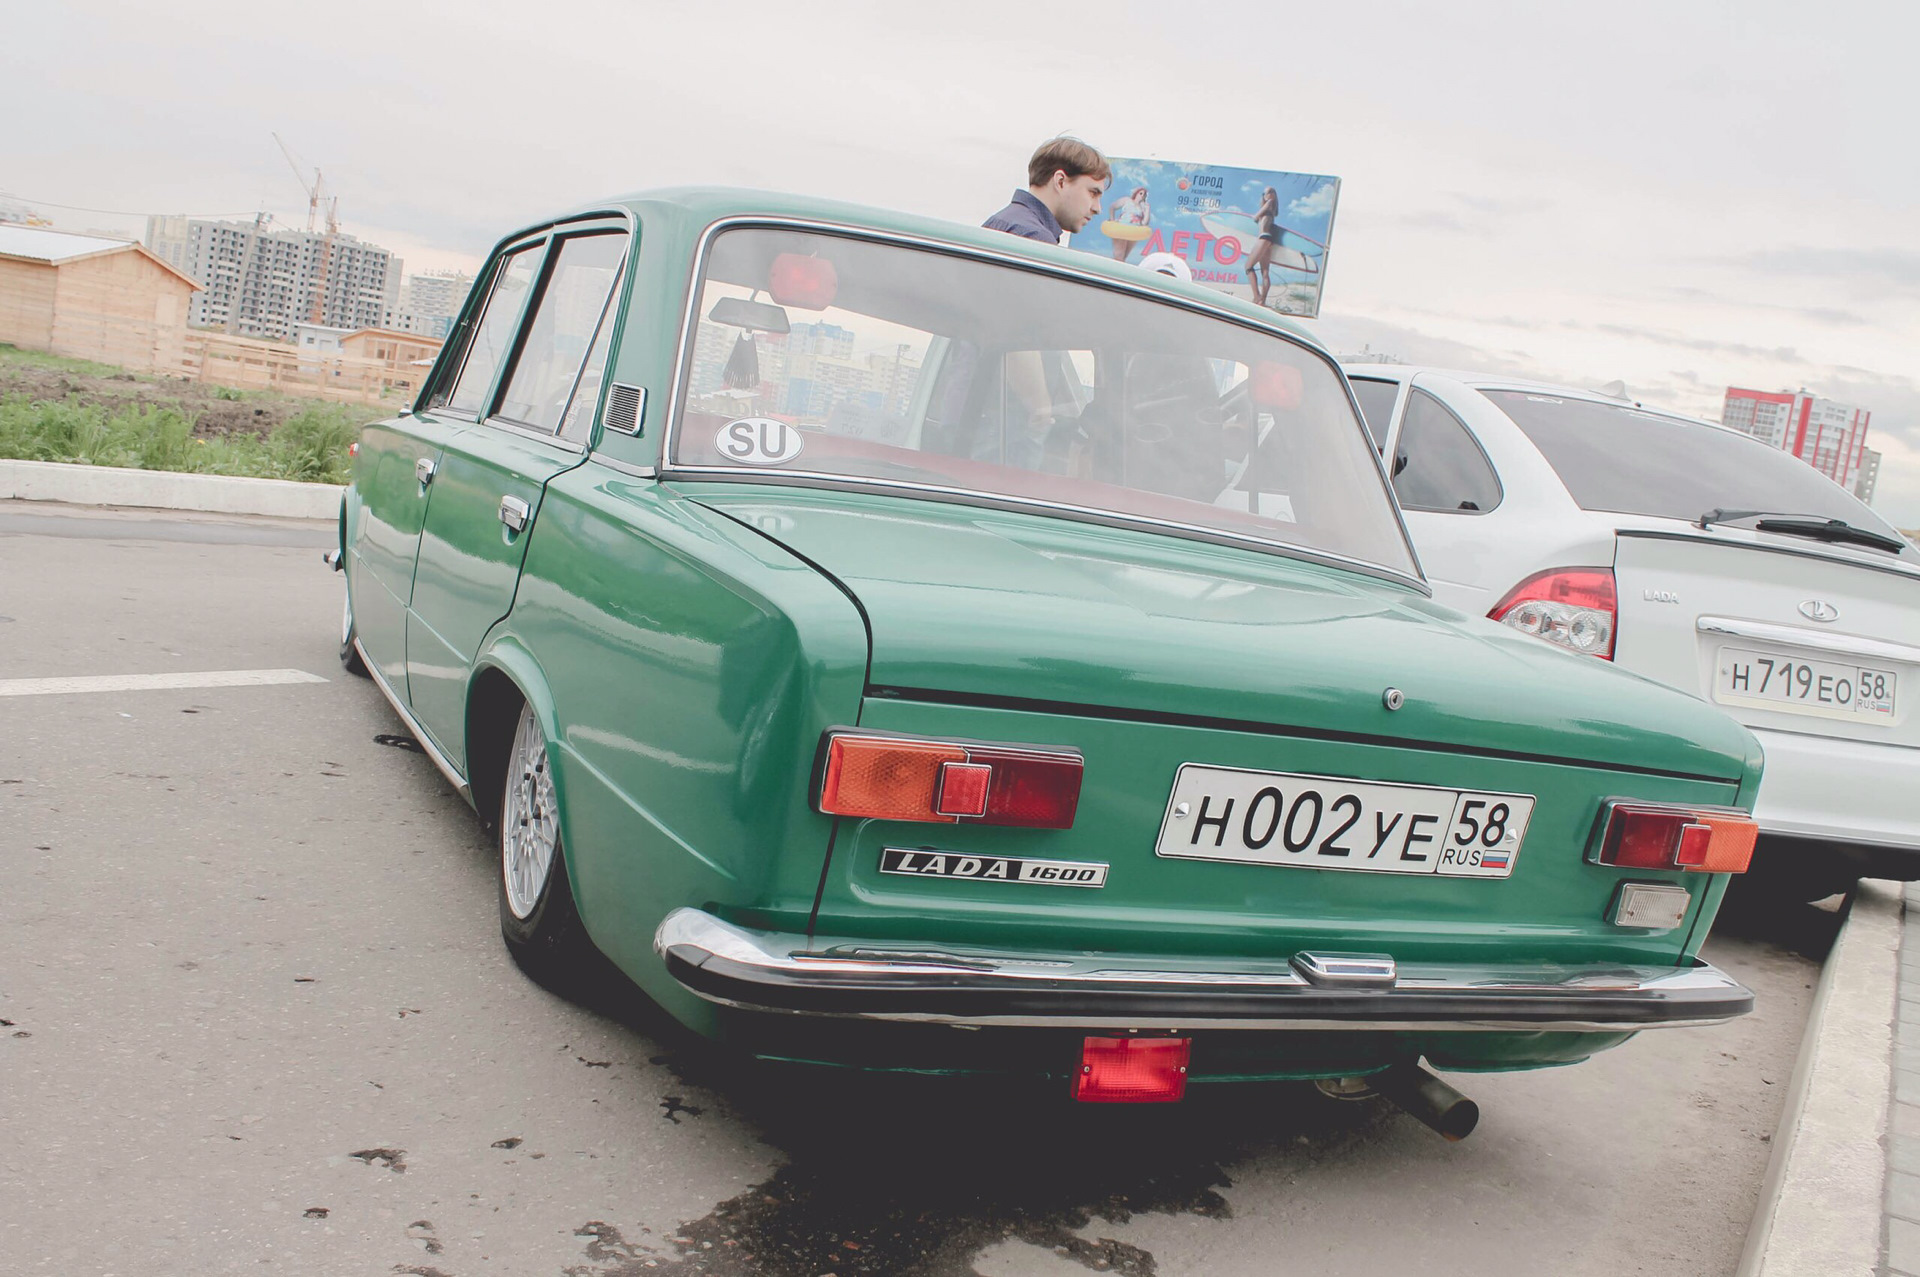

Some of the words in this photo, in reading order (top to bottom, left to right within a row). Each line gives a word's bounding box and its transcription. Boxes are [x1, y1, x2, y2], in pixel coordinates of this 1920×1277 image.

[1192, 175, 1223, 189] ГОРОД
[1141, 228, 1242, 265] ЛЕТО
[1190, 268, 1238, 285] ОРАМИ
[727, 422, 787, 458] SU
[1643, 589, 1679, 604] LADA
[1860, 672, 1885, 700] 58
[1857, 698, 1876, 711] RUS
[1454, 800, 1510, 848] 58
[897, 853, 1008, 879] LADA
[1029, 866, 1096, 882] 1600
[1442, 848, 1480, 867] RUS
